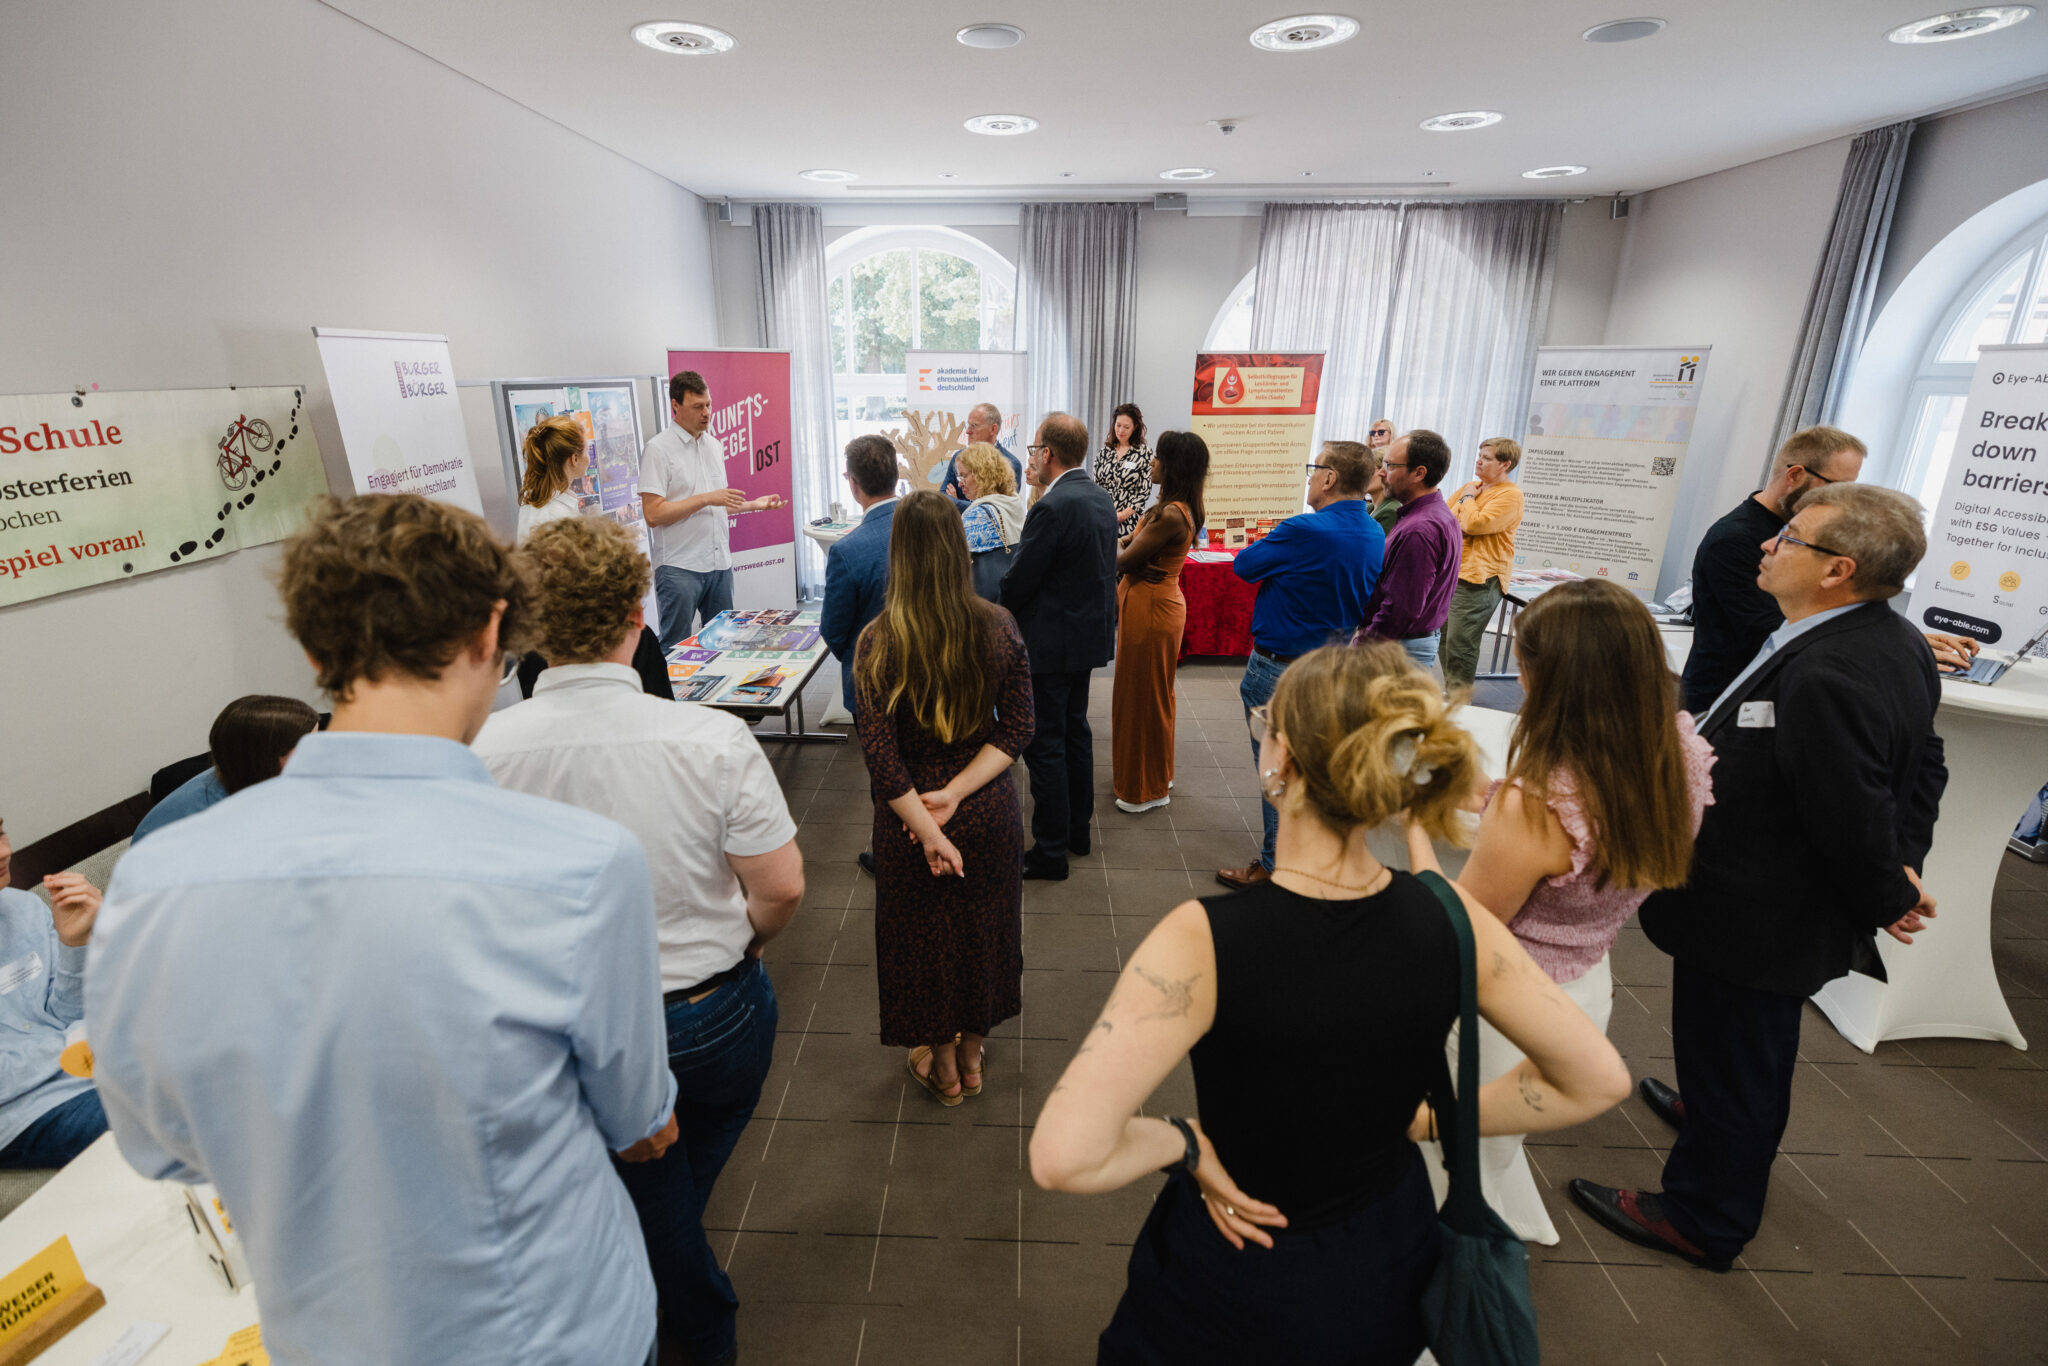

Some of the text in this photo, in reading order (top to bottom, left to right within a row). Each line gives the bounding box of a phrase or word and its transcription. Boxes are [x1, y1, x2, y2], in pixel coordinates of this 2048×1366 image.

[1540, 379, 1600, 387] EINE PLATTFORM
[1542, 369, 1636, 377] WIR GEBEN ENGAGEMENT
[1980, 410, 2048, 432] Break
[0, 420, 123, 454] Schule
[720, 427, 748, 461] EGE
[756, 439, 781, 472] OST
[1527, 448, 1565, 456] IMPULSGEBER
[1972, 440, 2037, 462] down
[0, 469, 133, 500] sterferien
[367, 457, 463, 490] Engagiert für Demokratie
[1523, 492, 1553, 500] ETZWERKER
[1560, 495, 1604, 505] MULTIPLIKATOR
[1954, 501, 2048, 524] Digital Accessib
[1520, 520, 1541, 528] RDERER
[1578, 527, 1632, 539] ENGAGEMENTPREIS
[1950, 517, 2041, 541] with ESG Values
[69, 530, 146, 560] voran!
[1946, 532, 2048, 559] Together for Inclu
[733, 557, 785, 572] NFTSWEGE-OST.DE
[1934, 614, 1990, 635] eye-able.com
